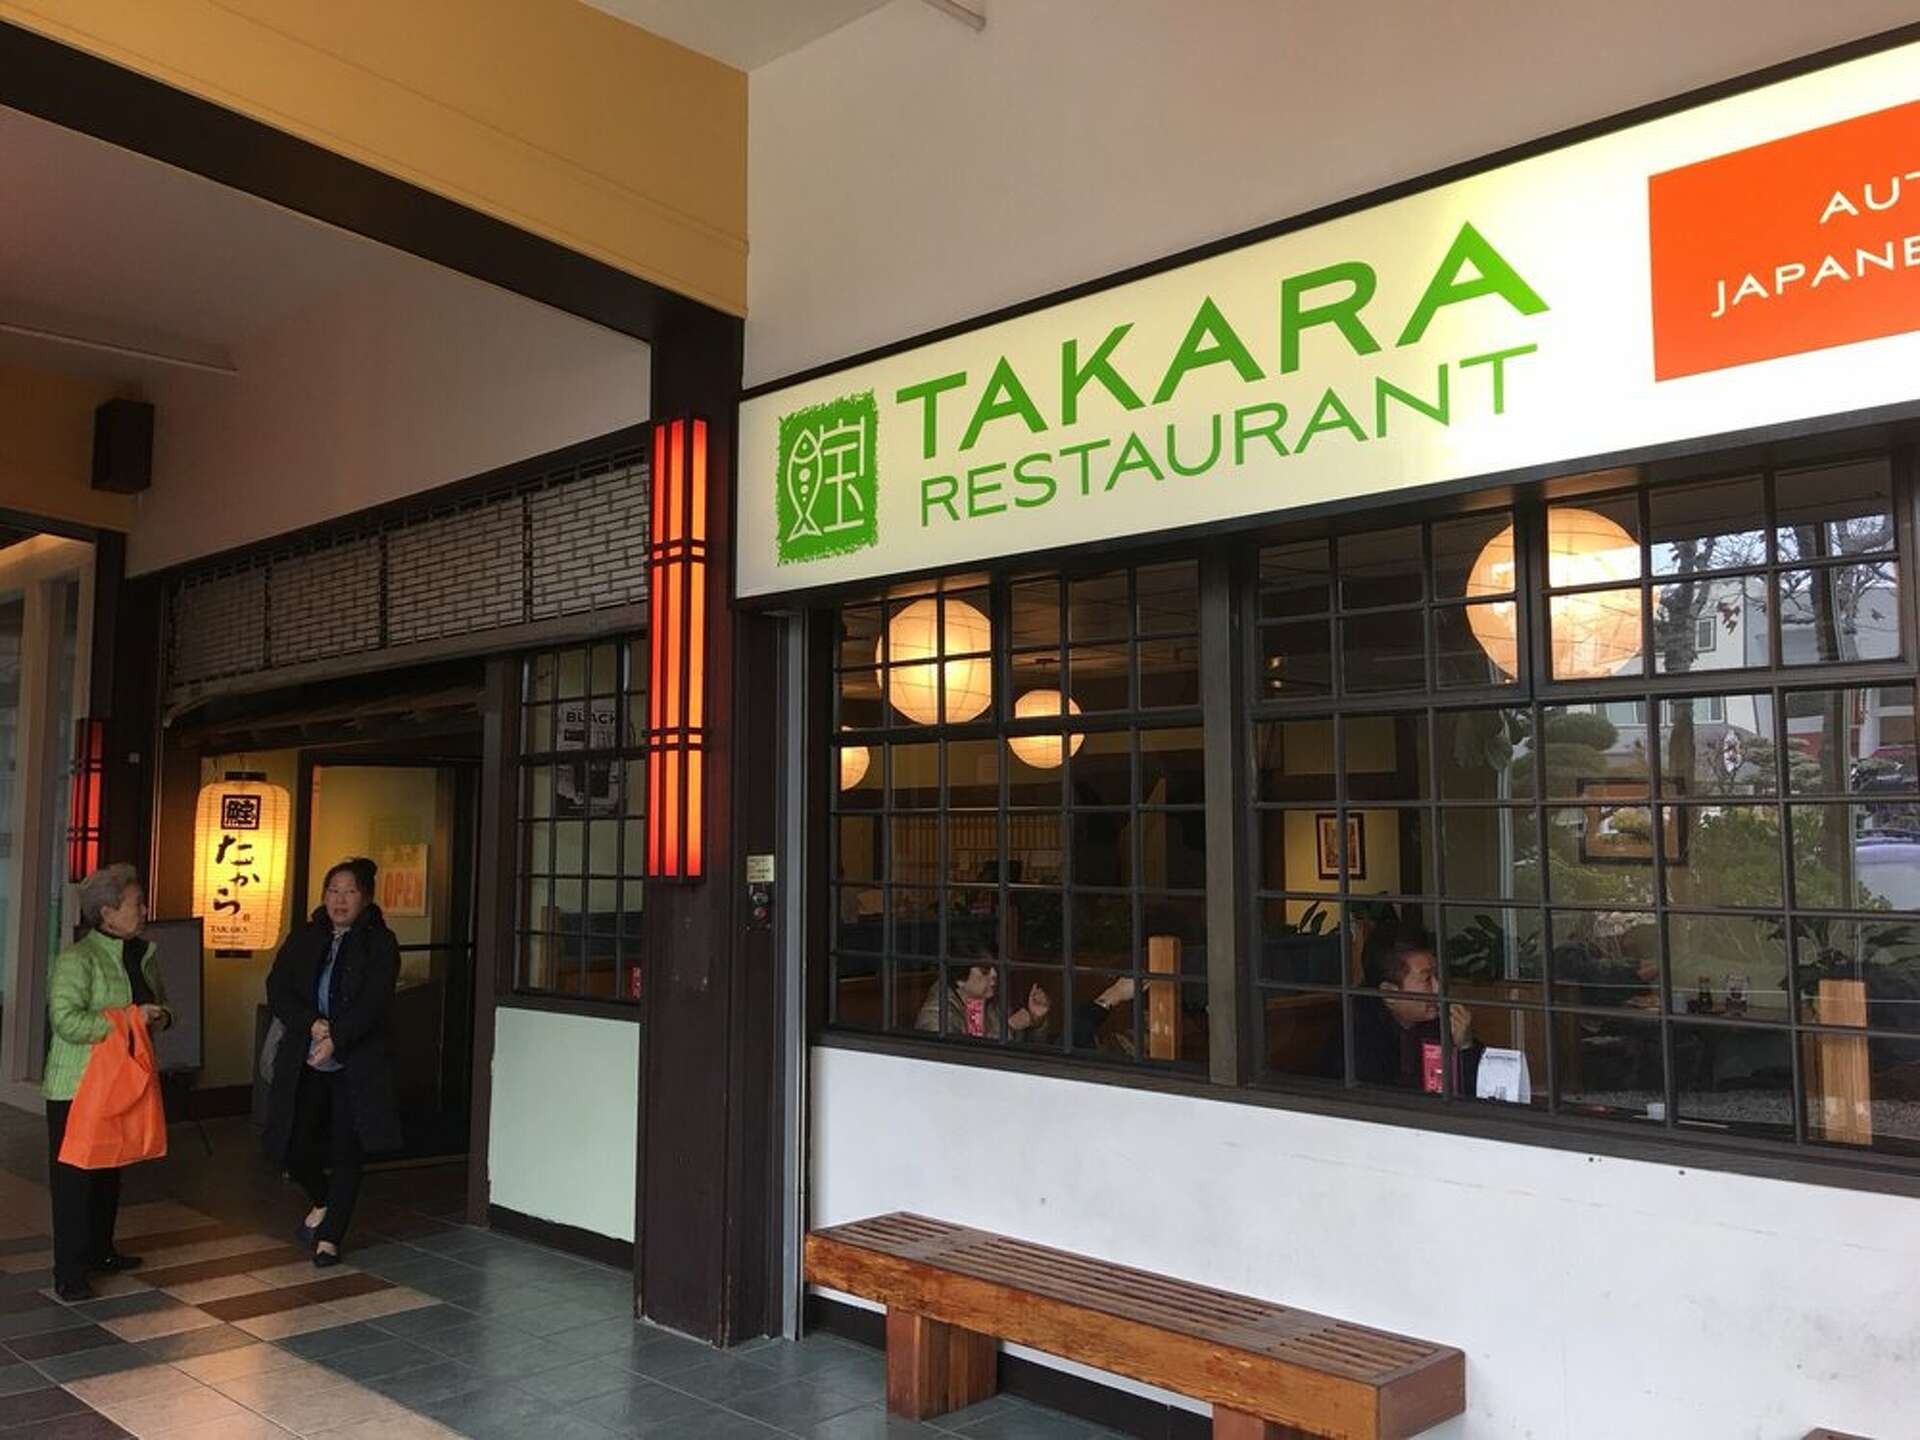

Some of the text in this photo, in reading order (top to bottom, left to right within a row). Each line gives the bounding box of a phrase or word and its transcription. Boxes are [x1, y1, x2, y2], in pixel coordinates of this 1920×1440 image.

[1819, 171, 1920, 223] AU
[895, 221, 1551, 460] TAKARA
[1711, 234, 1920, 318] JAPANE
[920, 342, 1538, 526] RESTAURANT
